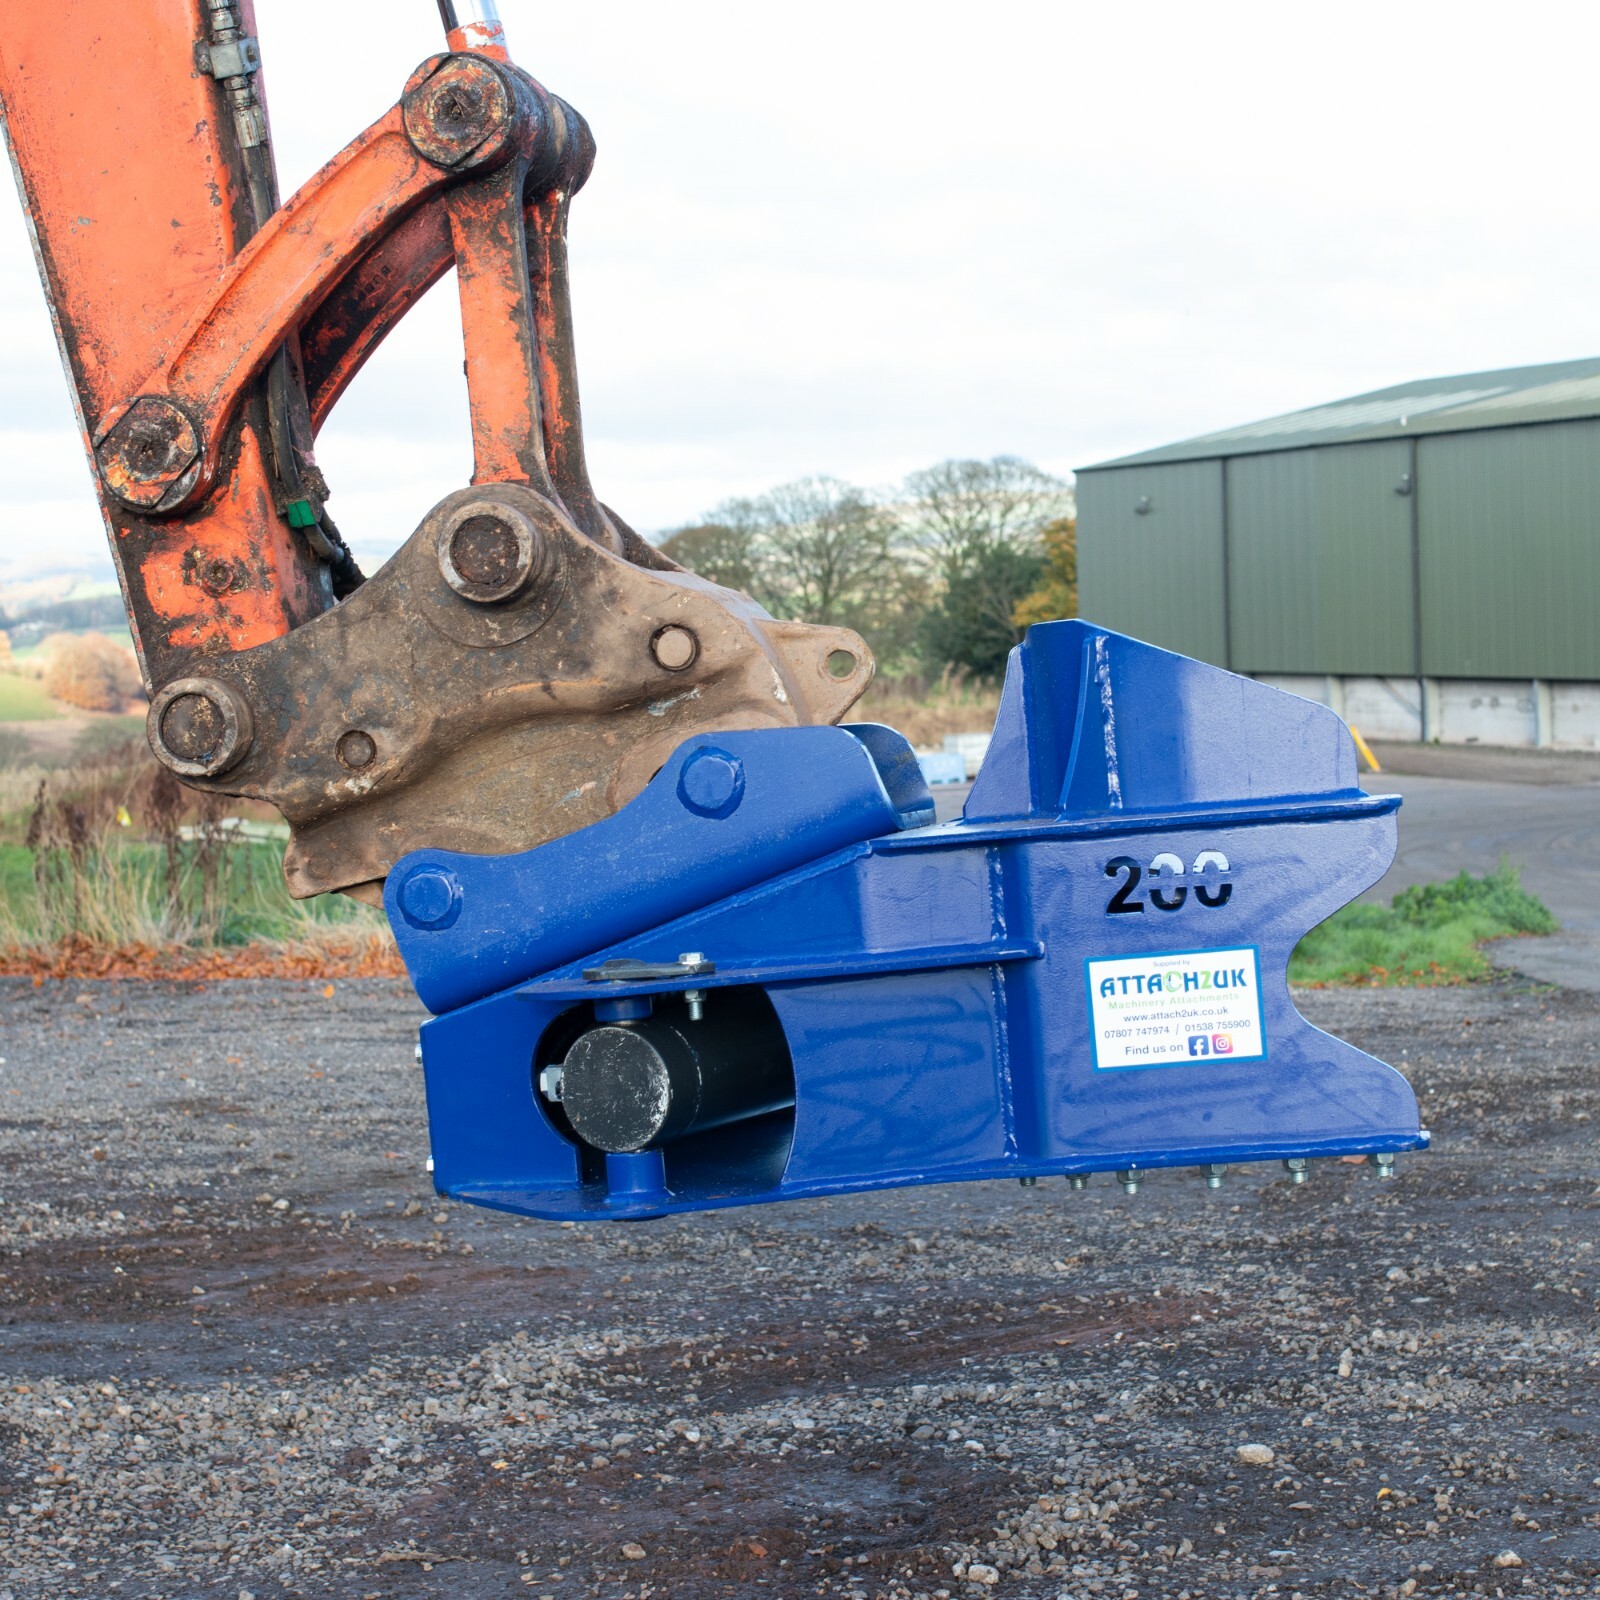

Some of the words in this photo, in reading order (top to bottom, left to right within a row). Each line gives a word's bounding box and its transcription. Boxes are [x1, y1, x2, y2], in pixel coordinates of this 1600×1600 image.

[1104, 849, 1232, 916] 200
[1153, 960, 1181, 968] Supplied
[1100, 968, 1247, 999] ATTACH2UK
[1108, 999, 1165, 1010] Machinery
[1169, 993, 1240, 1006] Attachments
[1123, 1006, 1229, 1022] www.attach2uk.co.uk
[1104, 1028, 1132, 1039] 07807
[1135, 1026, 1170, 1037] 747974
[1184, 1022, 1214, 1032] 01538
[1216, 1019, 1251, 1030] 755900
[1125, 1045, 1150, 1056] Find
[1153, 1045, 1166, 1054] us
[1169, 1044, 1184, 1052] on
